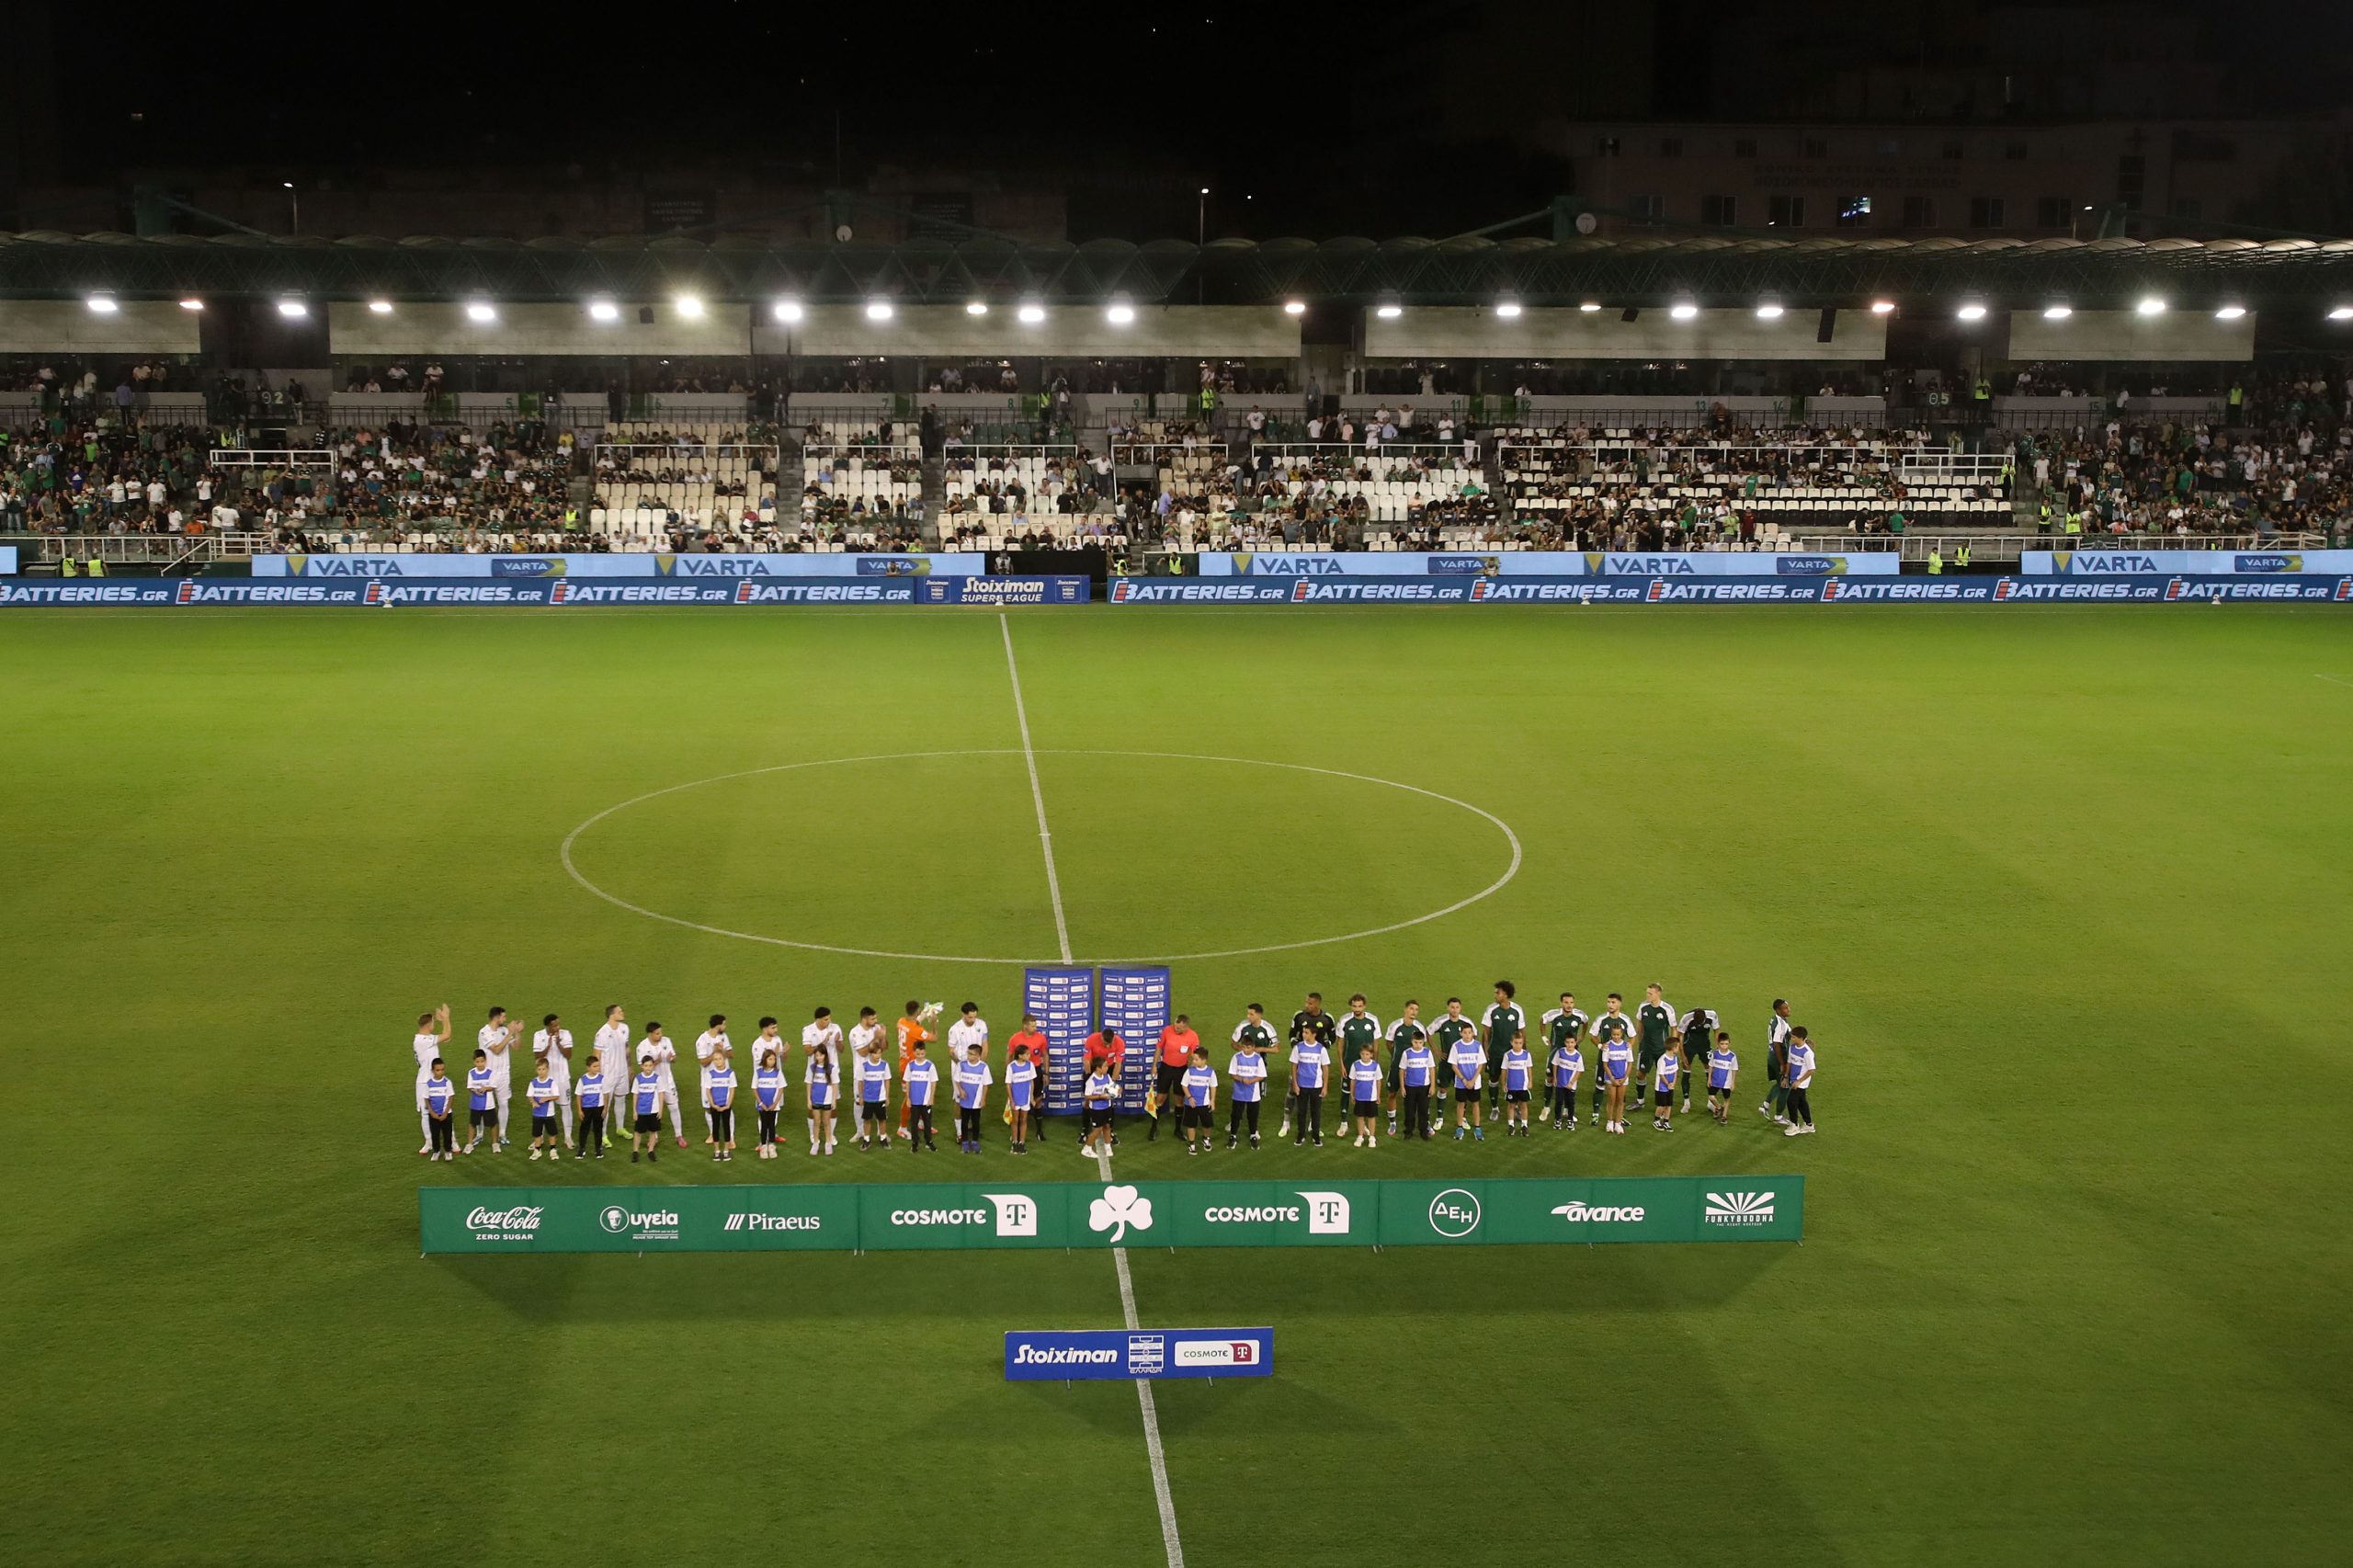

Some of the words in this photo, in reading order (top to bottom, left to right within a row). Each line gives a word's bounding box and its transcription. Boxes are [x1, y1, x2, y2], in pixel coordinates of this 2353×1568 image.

[1006, 398, 1014, 409] 8
[314, 560, 404, 575] VARTA
[502, 562, 548, 571] VARTA
[683, 560, 770, 575] VARTA
[1258, 558, 1345, 574] VARTA
[1611, 558, 1694, 574] VARTA
[1786, 561, 1830, 569] VARTA
[2078, 556, 2157, 572] VARTA
[2245, 558, 2287, 566] VARTA
[737, 584, 911, 601] BATTERIES.GR
[962, 576, 1044, 593] Stoiximan
[1112, 584, 1284, 600] BATTERIES.GR
[1292, 583, 1462, 599] BATTERIES.GR
[1471, 583, 1640, 599] BATTERIES.GR
[1648, 583, 1814, 599] BATTERIES.GR
[1823, 581, 1987, 599] BATTERIES.GR
[1995, 581, 2158, 598] BATTERIES.GR
[2166, 580, 2328, 598] BATTERIES.GR
[176, 584, 356, 602] BATTERIES.GR
[364, 585, 542, 602] BATTERIES.GR
[551, 585, 727, 601] BATTERIES.GR
[961, 594, 995, 603] SUPER
[466, 1206, 544, 1230] Coca-Cola
[631, 1210, 679, 1230] υγεία
[891, 1210, 986, 1225] COSMOTE
[1204, 1207, 1300, 1222] COSMOTE
[1435, 1201, 1472, 1223] ΔΕΗ
[1567, 1206, 1645, 1222] avance
[1705, 1214, 1774, 1223] FUNKYBUDDHA
[748, 1213, 820, 1231] Piraeus
[1013, 1344, 1119, 1364] Stoiximan
[1183, 1350, 1229, 1358] COSMOTE
